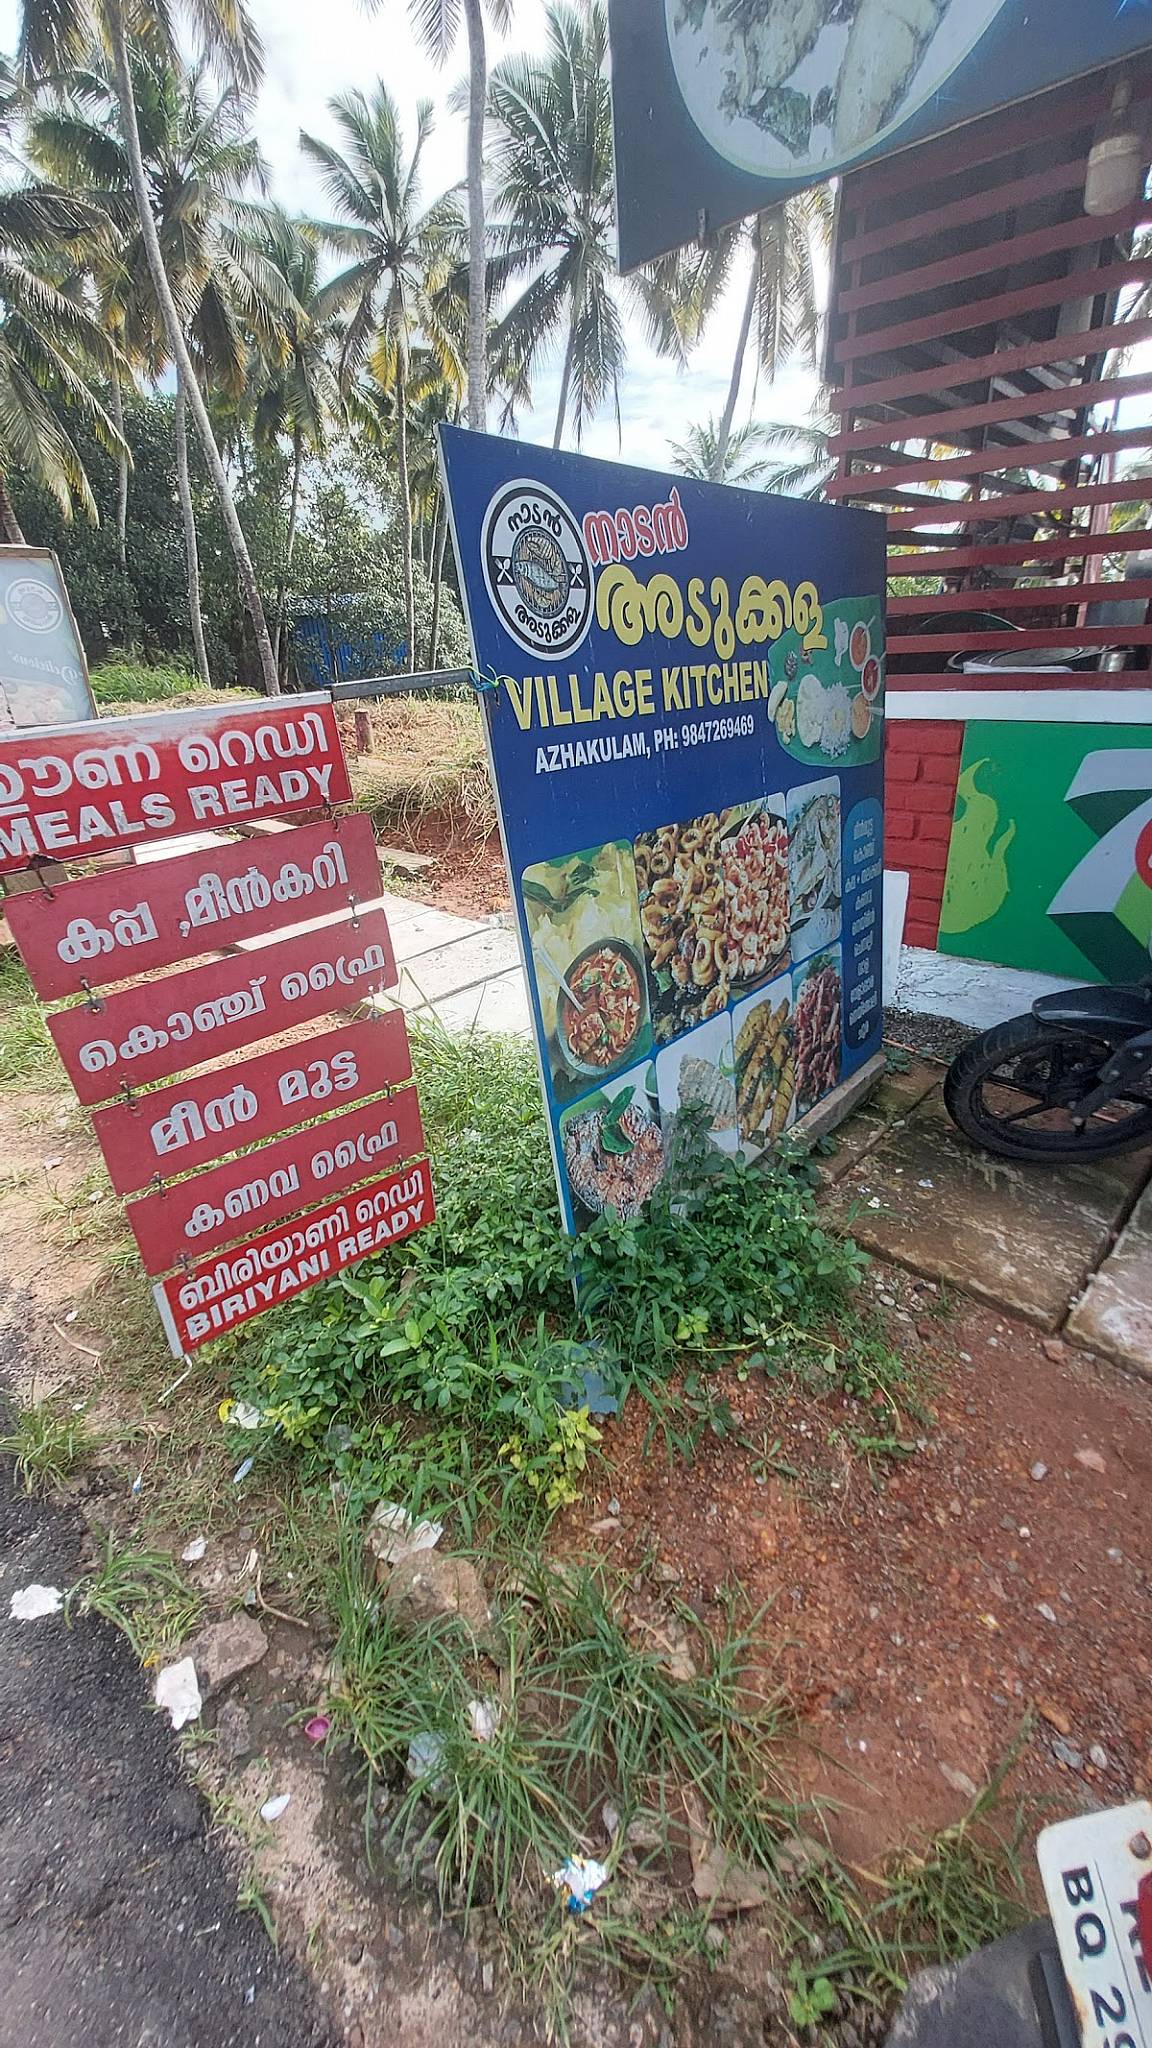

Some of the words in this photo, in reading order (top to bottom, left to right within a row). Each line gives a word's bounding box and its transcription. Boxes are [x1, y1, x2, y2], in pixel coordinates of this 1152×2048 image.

[508, 503, 563, 537] നാടൻ
[582, 486, 689, 567] നാടൻ
[596, 563, 828, 660] അടുക്കള
[178, 712, 329, 773] റെഡി
[504, 669, 655, 730] VILLAGE
[661, 660, 769, 712] KITCHEN
[535, 732, 651, 774] AZHAKULAM,
[654, 727, 679, 752] PH:
[682, 714, 755, 747] 9847269469
[0, 793, 176, 860] MEALS
[188, 764, 333, 820] READY
[79, 975, 267, 1072] കൊഞ്ച്
[150, 1084, 259, 1156] മീൻ
[277, 1050, 360, 1106] മുട്ട
[178, 1205, 350, 1310] ബിരിയാണി
[355, 1169, 424, 1223] റെഡി
[184, 1163, 300, 1238] കണവ
[184, 1250, 330, 1340] BIRIYANI
[337, 1200, 425, 1263] READY
[1061, 1866, 1106, 1961] BQ
